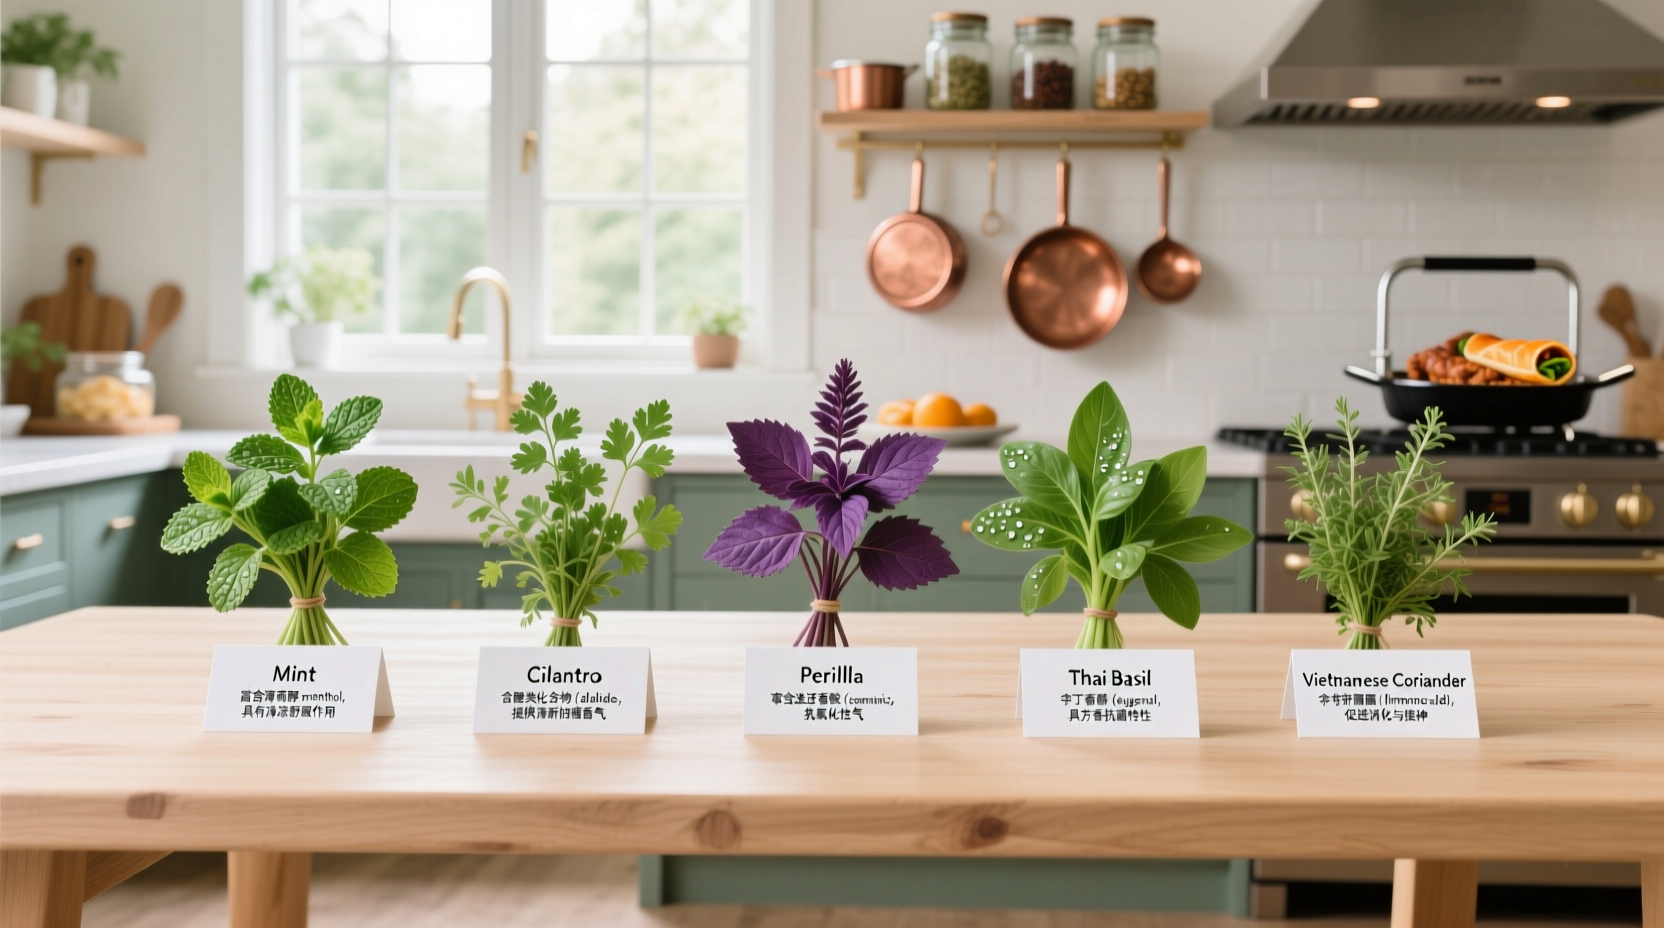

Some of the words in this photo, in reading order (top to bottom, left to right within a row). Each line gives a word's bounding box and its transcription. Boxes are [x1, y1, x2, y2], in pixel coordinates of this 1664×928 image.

[273, 665, 316, 682] Mint
[527, 665, 602, 683] Cilantro
[801, 665, 863, 683] Perillla
[1069, 669, 1106, 686] Thai
[1112, 669, 1151, 686] Basil
[1393, 673, 1466, 687] Coriander
